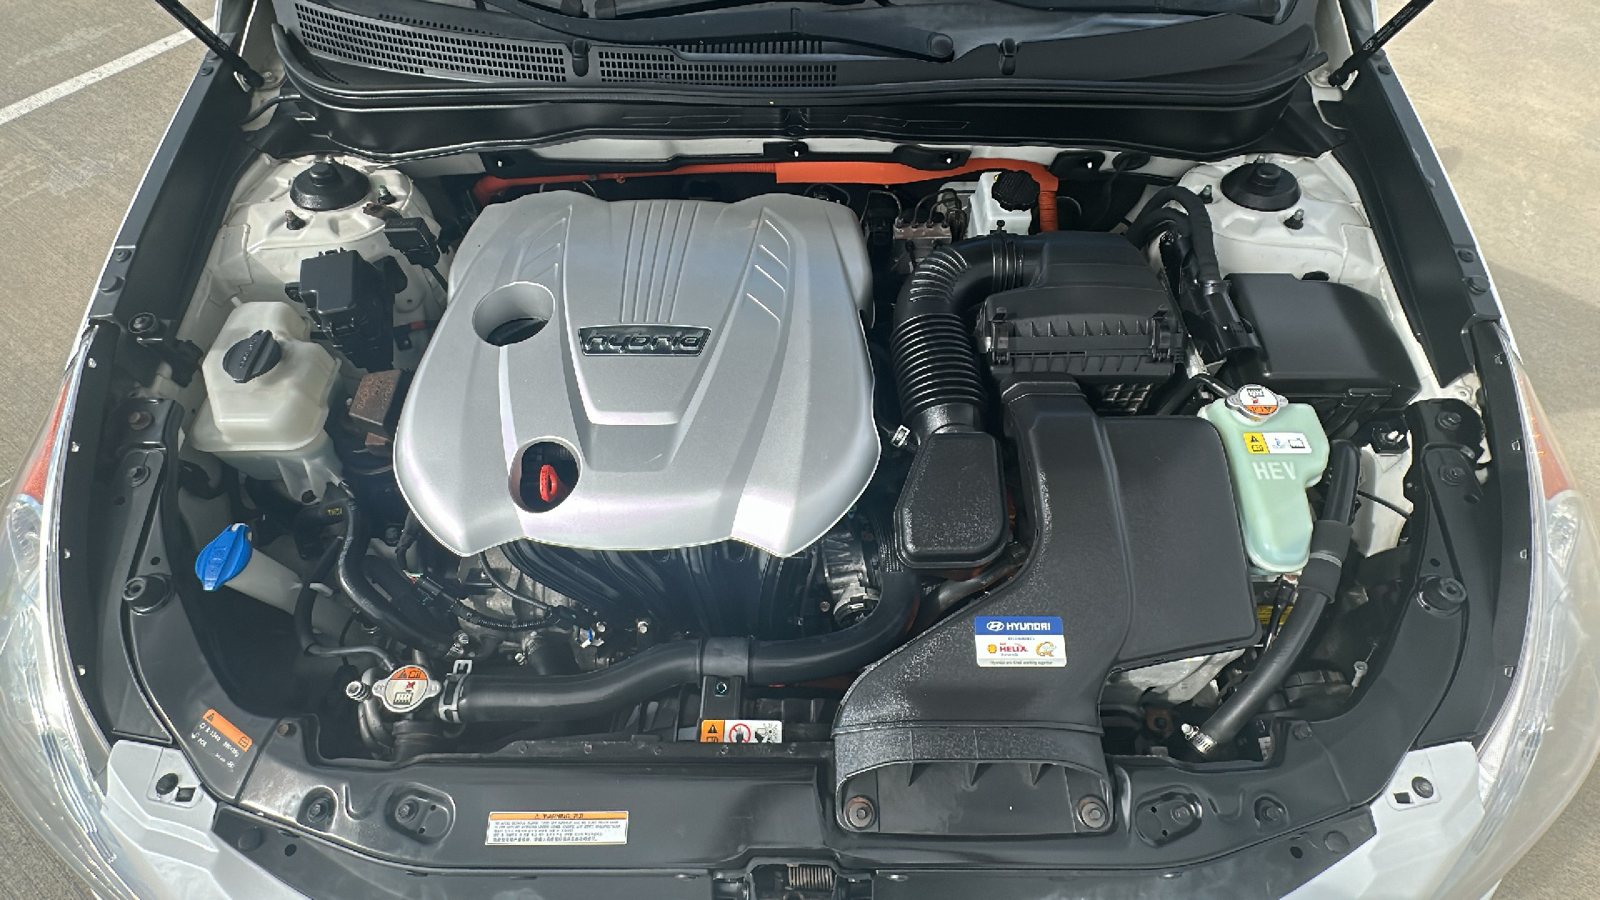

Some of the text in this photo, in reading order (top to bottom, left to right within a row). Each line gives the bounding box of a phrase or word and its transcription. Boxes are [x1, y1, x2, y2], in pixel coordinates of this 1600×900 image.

[1252, 461, 1296, 480] HEV
[1006, 622, 1051, 631] HYUNDAI
[999, 645, 1027, 653] HELIX
